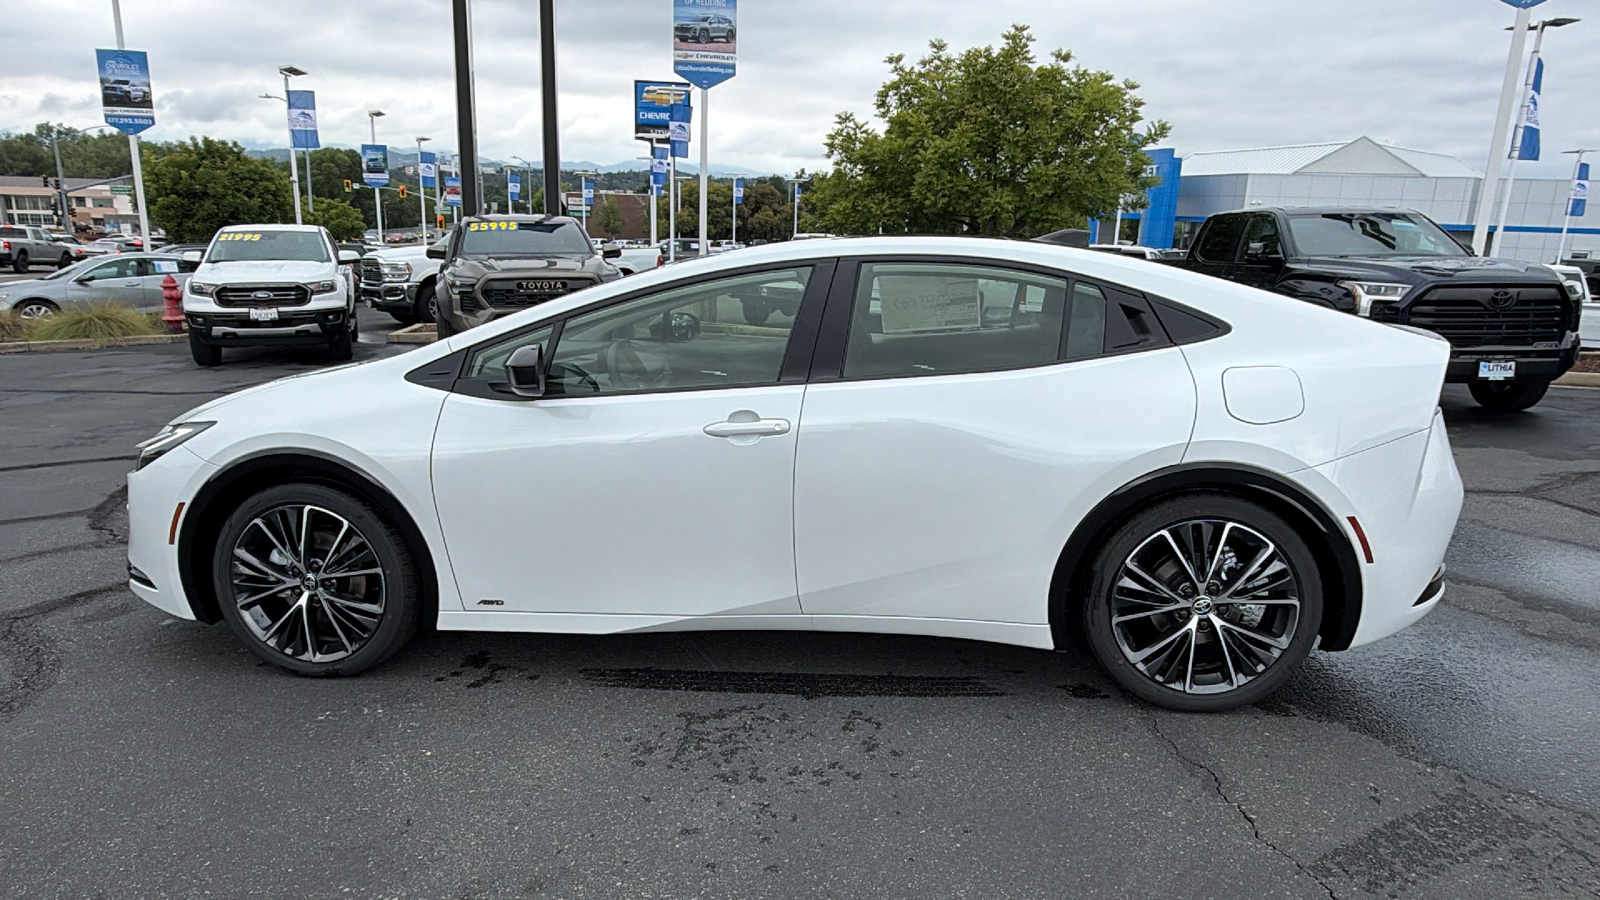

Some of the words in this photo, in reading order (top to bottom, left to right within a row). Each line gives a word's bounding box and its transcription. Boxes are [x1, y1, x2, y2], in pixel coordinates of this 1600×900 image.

[469, 222, 518, 231] 55995
[218, 233, 262, 241] 21995
[1488, 364, 1514, 372] LITHIA
